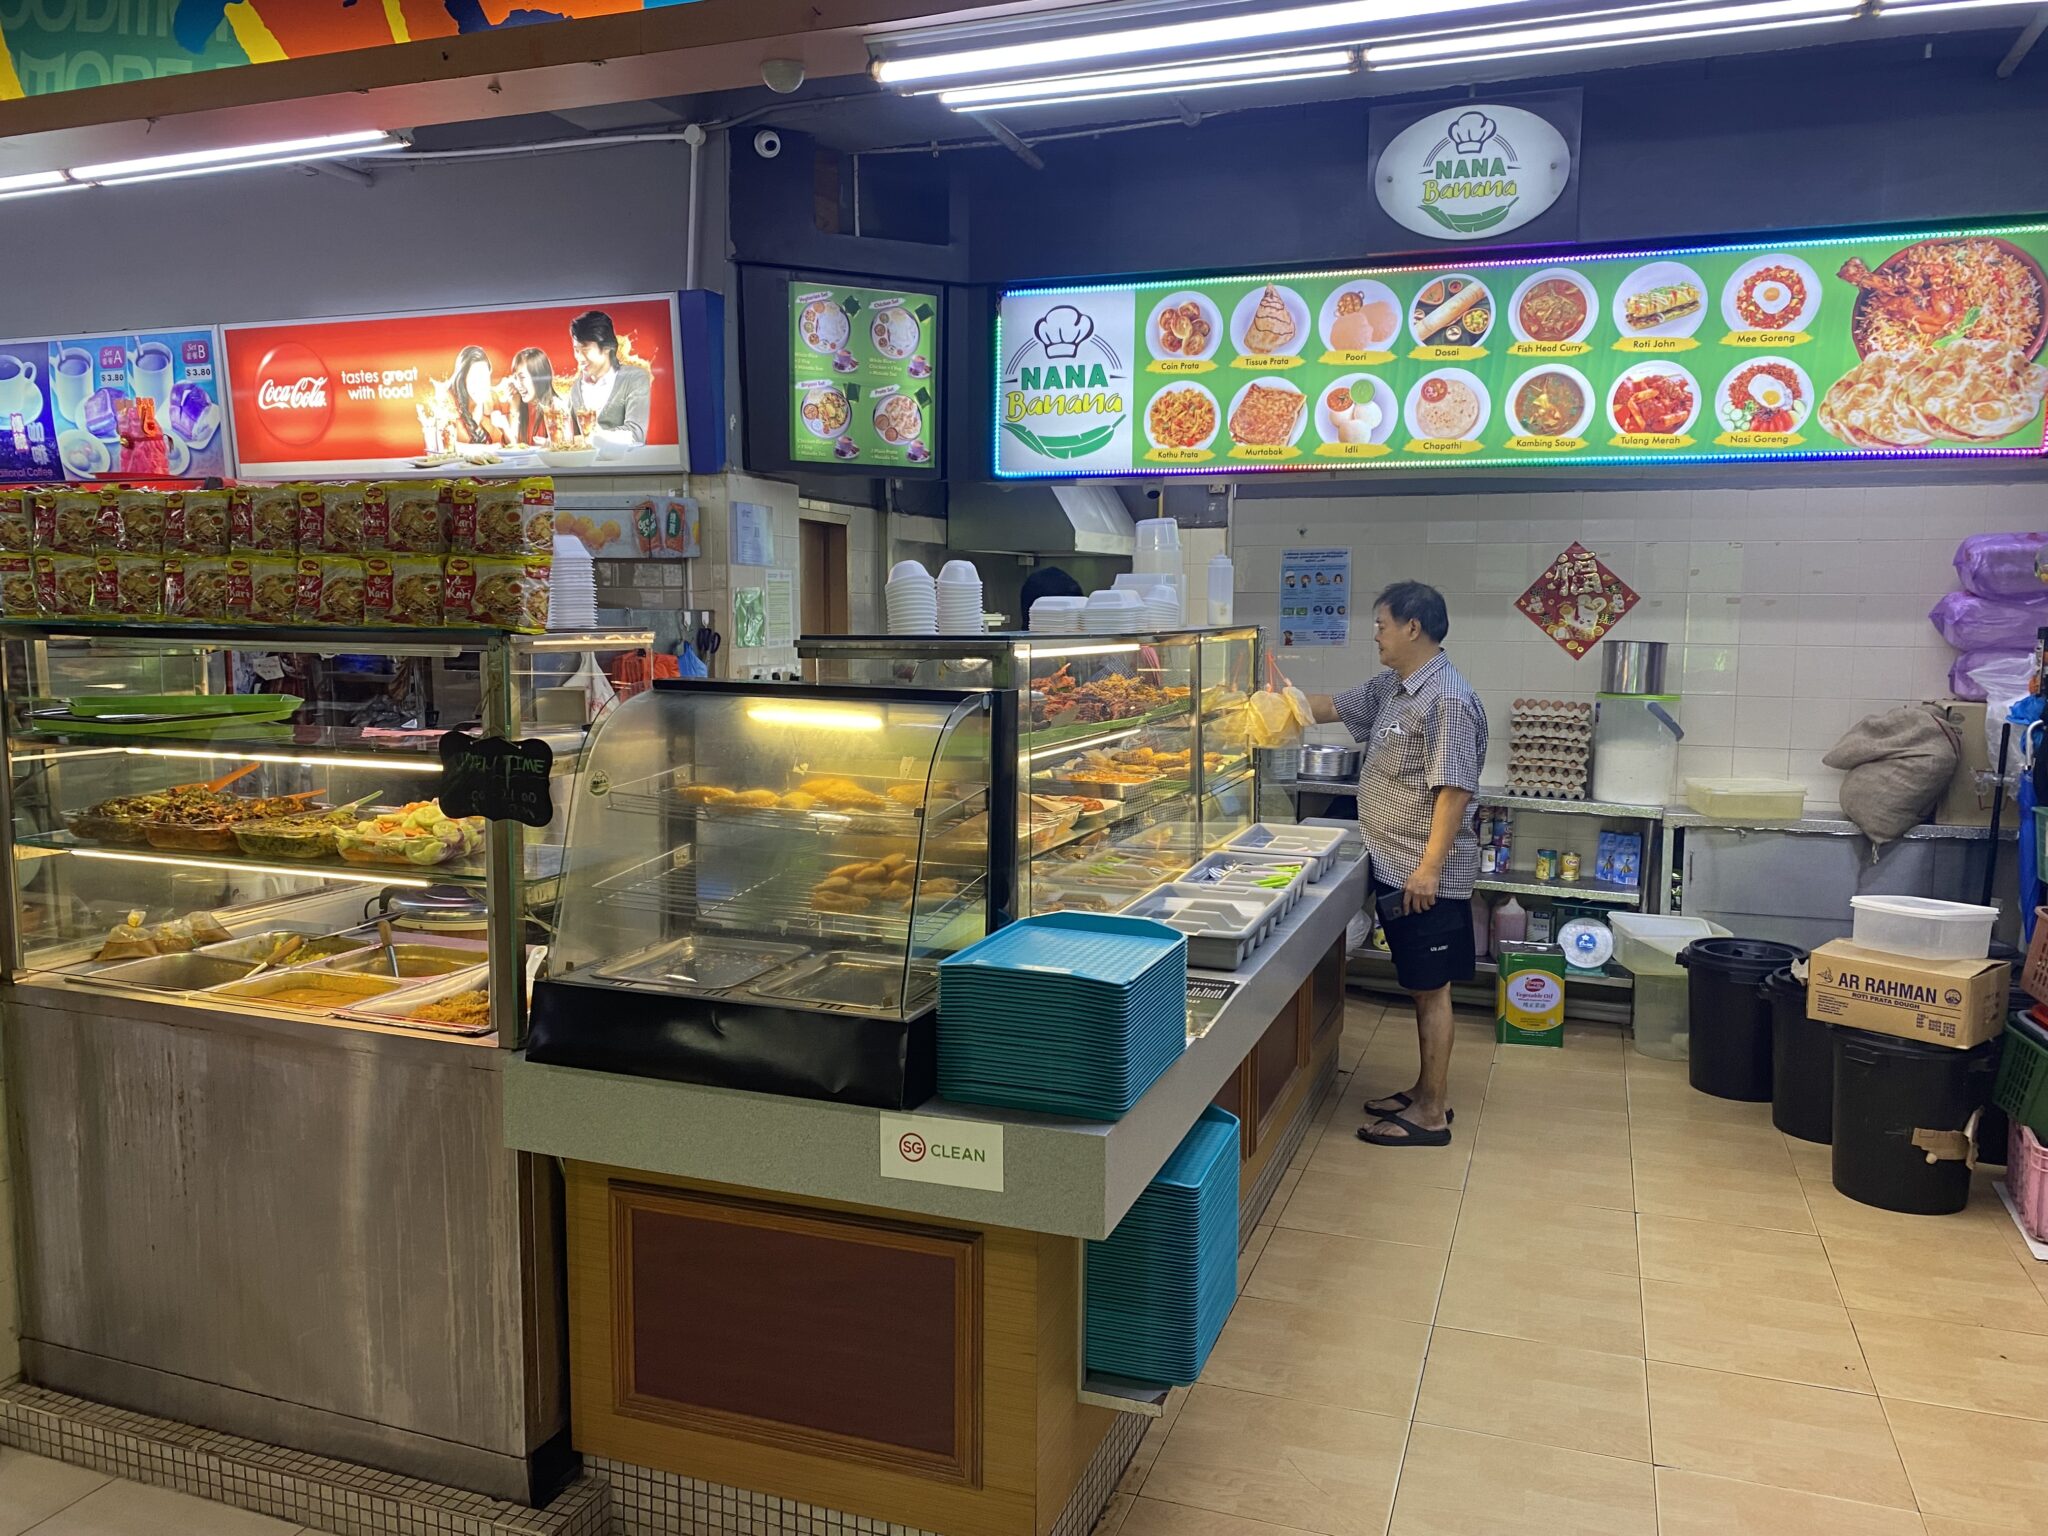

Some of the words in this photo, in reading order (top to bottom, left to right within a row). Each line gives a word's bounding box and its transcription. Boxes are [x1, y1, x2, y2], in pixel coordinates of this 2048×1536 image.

[1436, 157, 1507, 180] NANA
[1422, 179, 1517, 204] Banana
[1633, 339, 1651, 349] Roti
[1654, 338, 1676, 349] John
[1737, 333, 1756, 344] Mee
[1760, 332, 1795, 344] Goreng
[198, 343, 206, 359] B
[1435, 347, 1460, 357] Dosai
[1517, 344, 1533, 354] Fish
[1536, 342, 1556, 352] Head
[1558, 342, 1583, 355] Curry
[113, 350, 123, 364] A
[1245, 358, 1266, 367] Tissue
[1269, 357, 1289, 366] Prata
[1345, 352, 1367, 362] Poori
[1161, 362, 1178, 371] Coin
[1180, 362, 1200, 370] Prata
[341, 369, 379, 385] tastes
[382, 366, 418, 387] great
[1021, 362, 1110, 391] NANA
[258, 376, 328, 411] Coca-Cola
[348, 386, 376, 400] with
[378, 382, 414, 400] food!
[1005, 388, 1122, 422] Banana
[1423, 441, 1463, 451] Chapathi
[1516, 437, 1552, 450] Kambing
[1555, 437, 1576, 449] Soup
[1620, 435, 1649, 447] Tulang
[1651, 434, 1681, 445] Merah
[1730, 433, 1752, 444] Nasi
[1755, 432, 1789, 447] Goreng
[1158, 450, 1177, 459] Kothu
[1179, 450, 1198, 459] Prata
[1245, 447, 1284, 457] Murtabak
[1345, 445, 1359, 454] Idli
[1547, 551, 1603, 597] 福
[503, 754, 546, 780] TIME
[1838, 973, 1860, 990] AR
[1865, 977, 1937, 1004] RAHMAN
[1852, 992, 1869, 1001] ROTI
[1870, 995, 1893, 1006] PRATA
[1894, 999, 1920, 1011] DOUGH
[903, 1140, 923, 1155] SG
[931, 1144, 985, 1163] CLEAN
